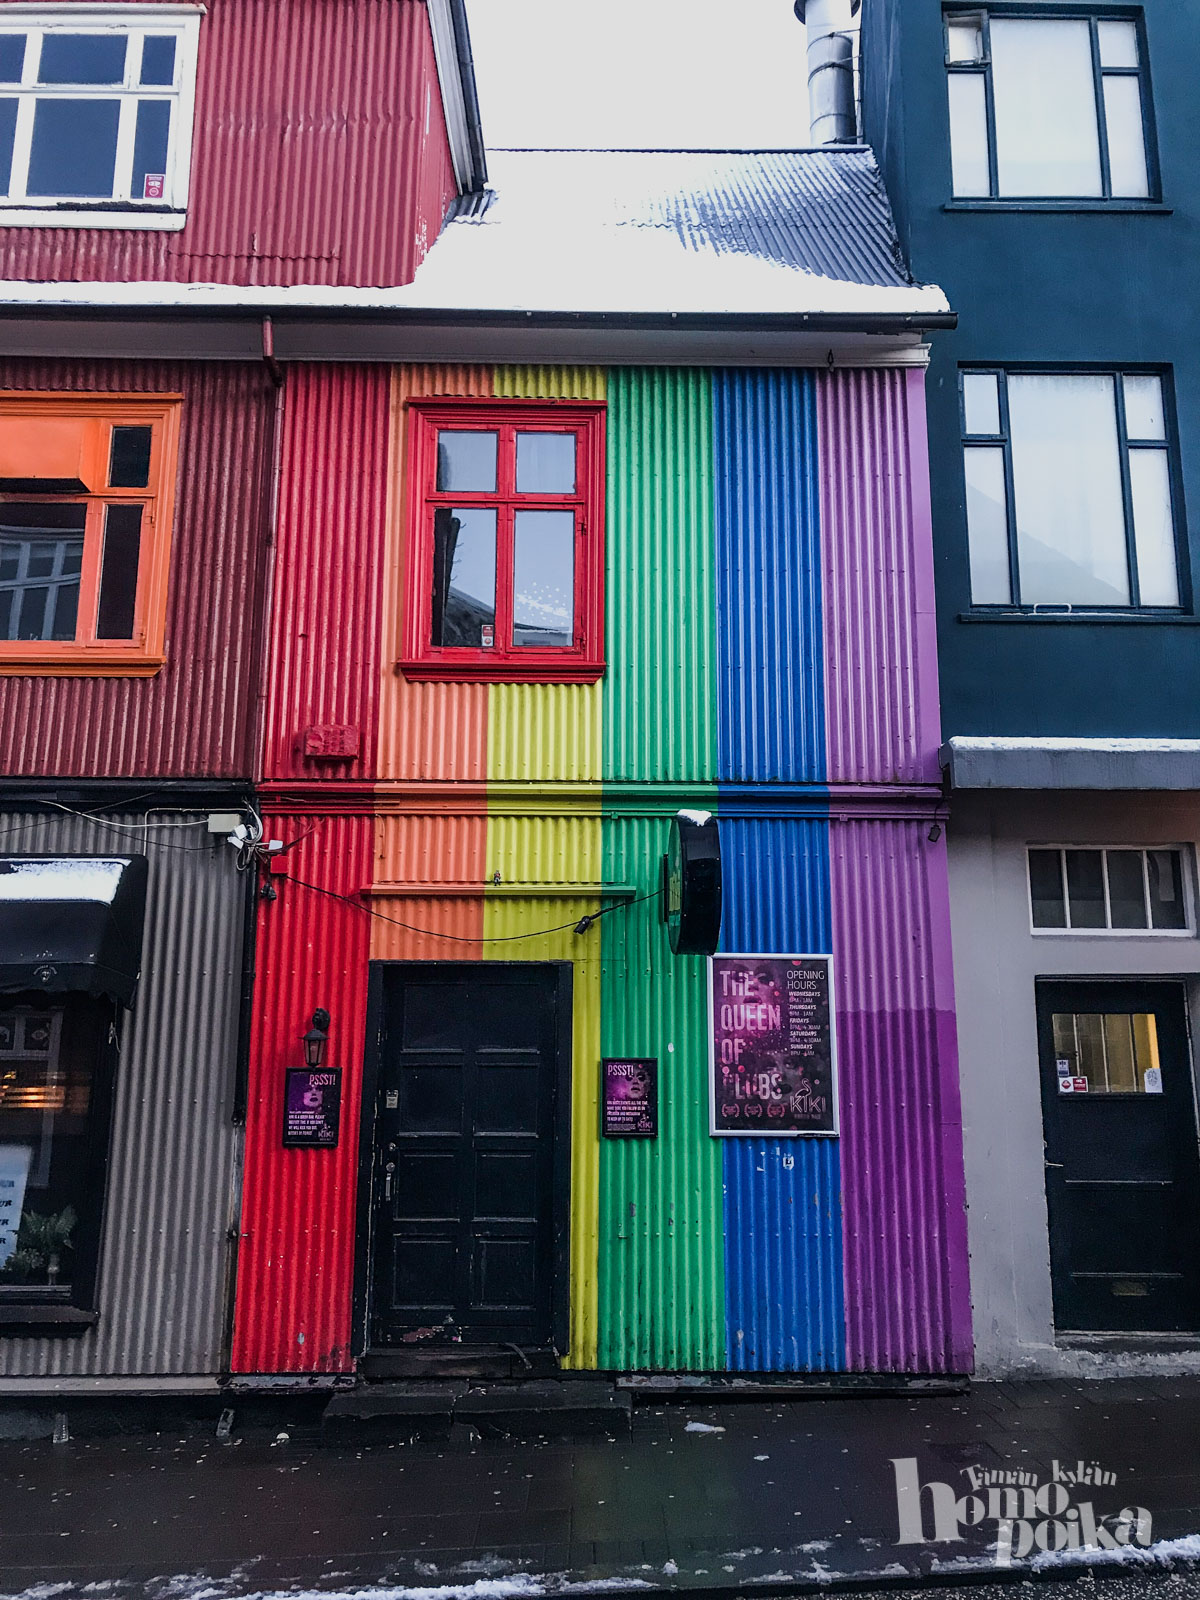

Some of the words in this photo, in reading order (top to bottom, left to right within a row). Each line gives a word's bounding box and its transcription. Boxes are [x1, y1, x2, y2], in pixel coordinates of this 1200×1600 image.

[786, 970, 825, 980] OPENING
[720, 970, 755, 996] THE
[787, 981, 817, 990] HOURS
[721, 1004, 781, 1032] QUEEN
[721, 1038, 743, 1065] OF
[607, 1064, 634, 1076] PSSST!
[309, 1074, 336, 1086] PSSST!
[789, 1095, 827, 1113] KIKI
